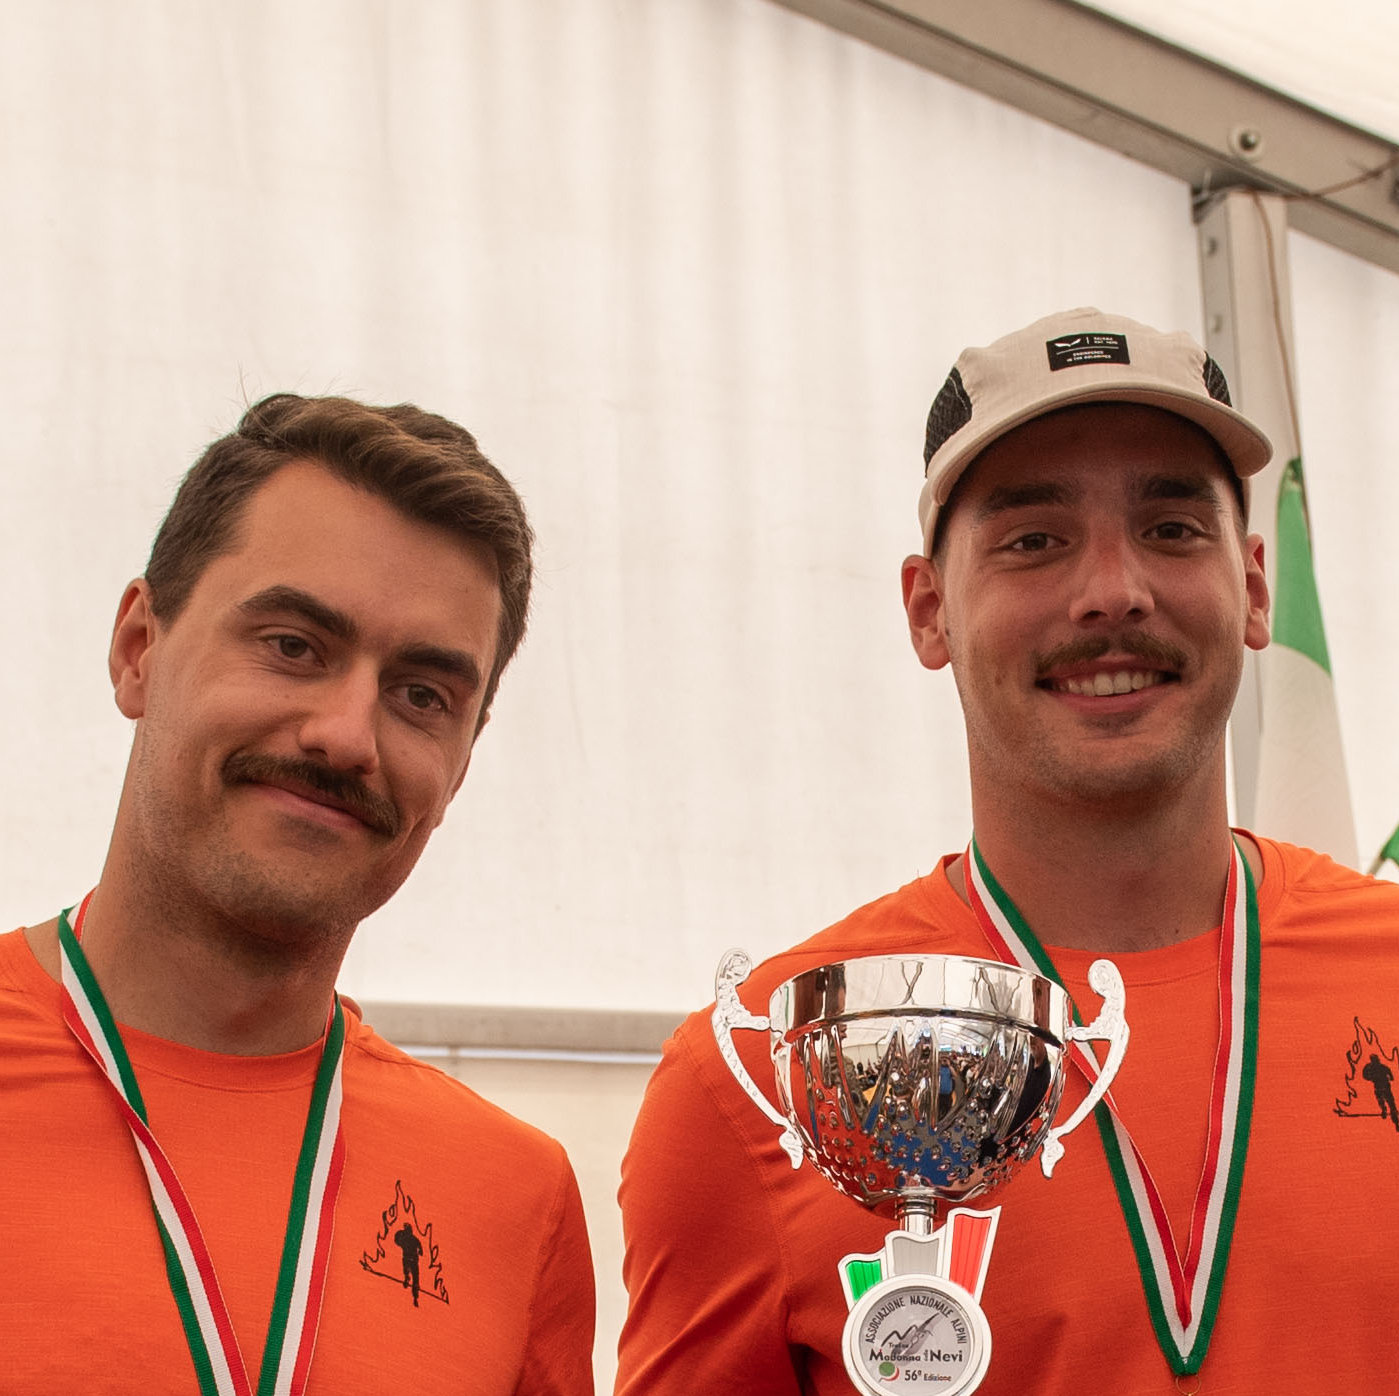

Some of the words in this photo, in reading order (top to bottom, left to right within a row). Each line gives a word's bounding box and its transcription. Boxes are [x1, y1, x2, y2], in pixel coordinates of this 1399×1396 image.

[865, 1297, 905, 1343] ASSOCIAZIONE
[910, 1295, 954, 1318] NAZIONALE
[951, 1319, 967, 1344] ALPINI
[869, 1348, 921, 1362] Madonna
[929, 1349, 963, 1362] Nevi
[923, 1373, 952, 1382] Edizione
